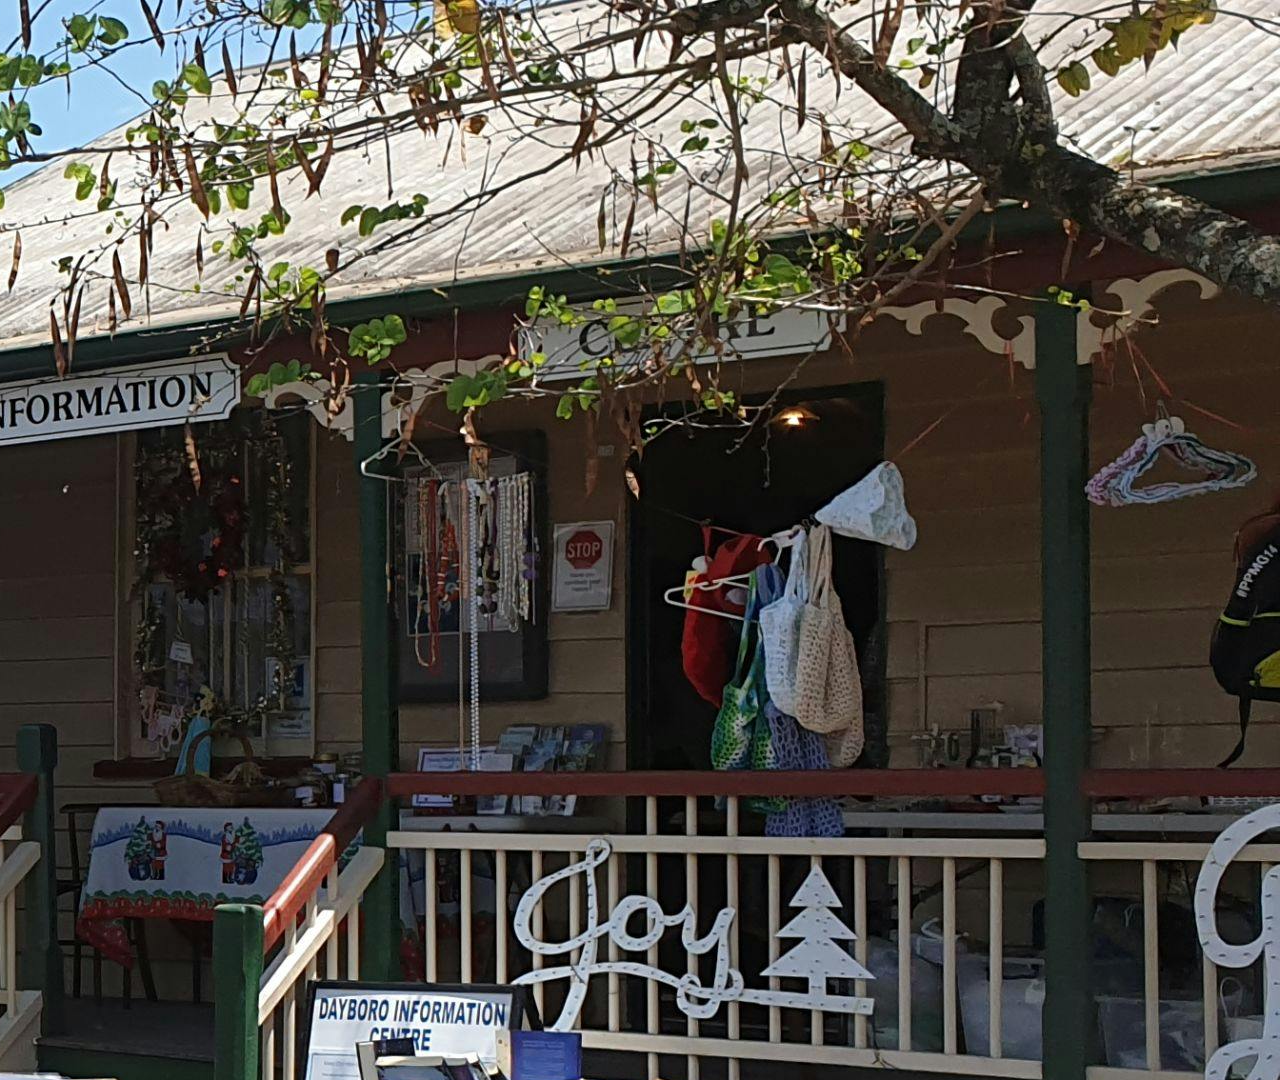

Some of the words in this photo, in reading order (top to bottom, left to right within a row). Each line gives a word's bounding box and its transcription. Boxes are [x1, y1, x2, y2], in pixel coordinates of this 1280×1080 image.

[567, 542, 601, 559] STOP
[319, 997, 389, 1021] DAYBORO
[394, 1000, 506, 1026] INFORMATION
